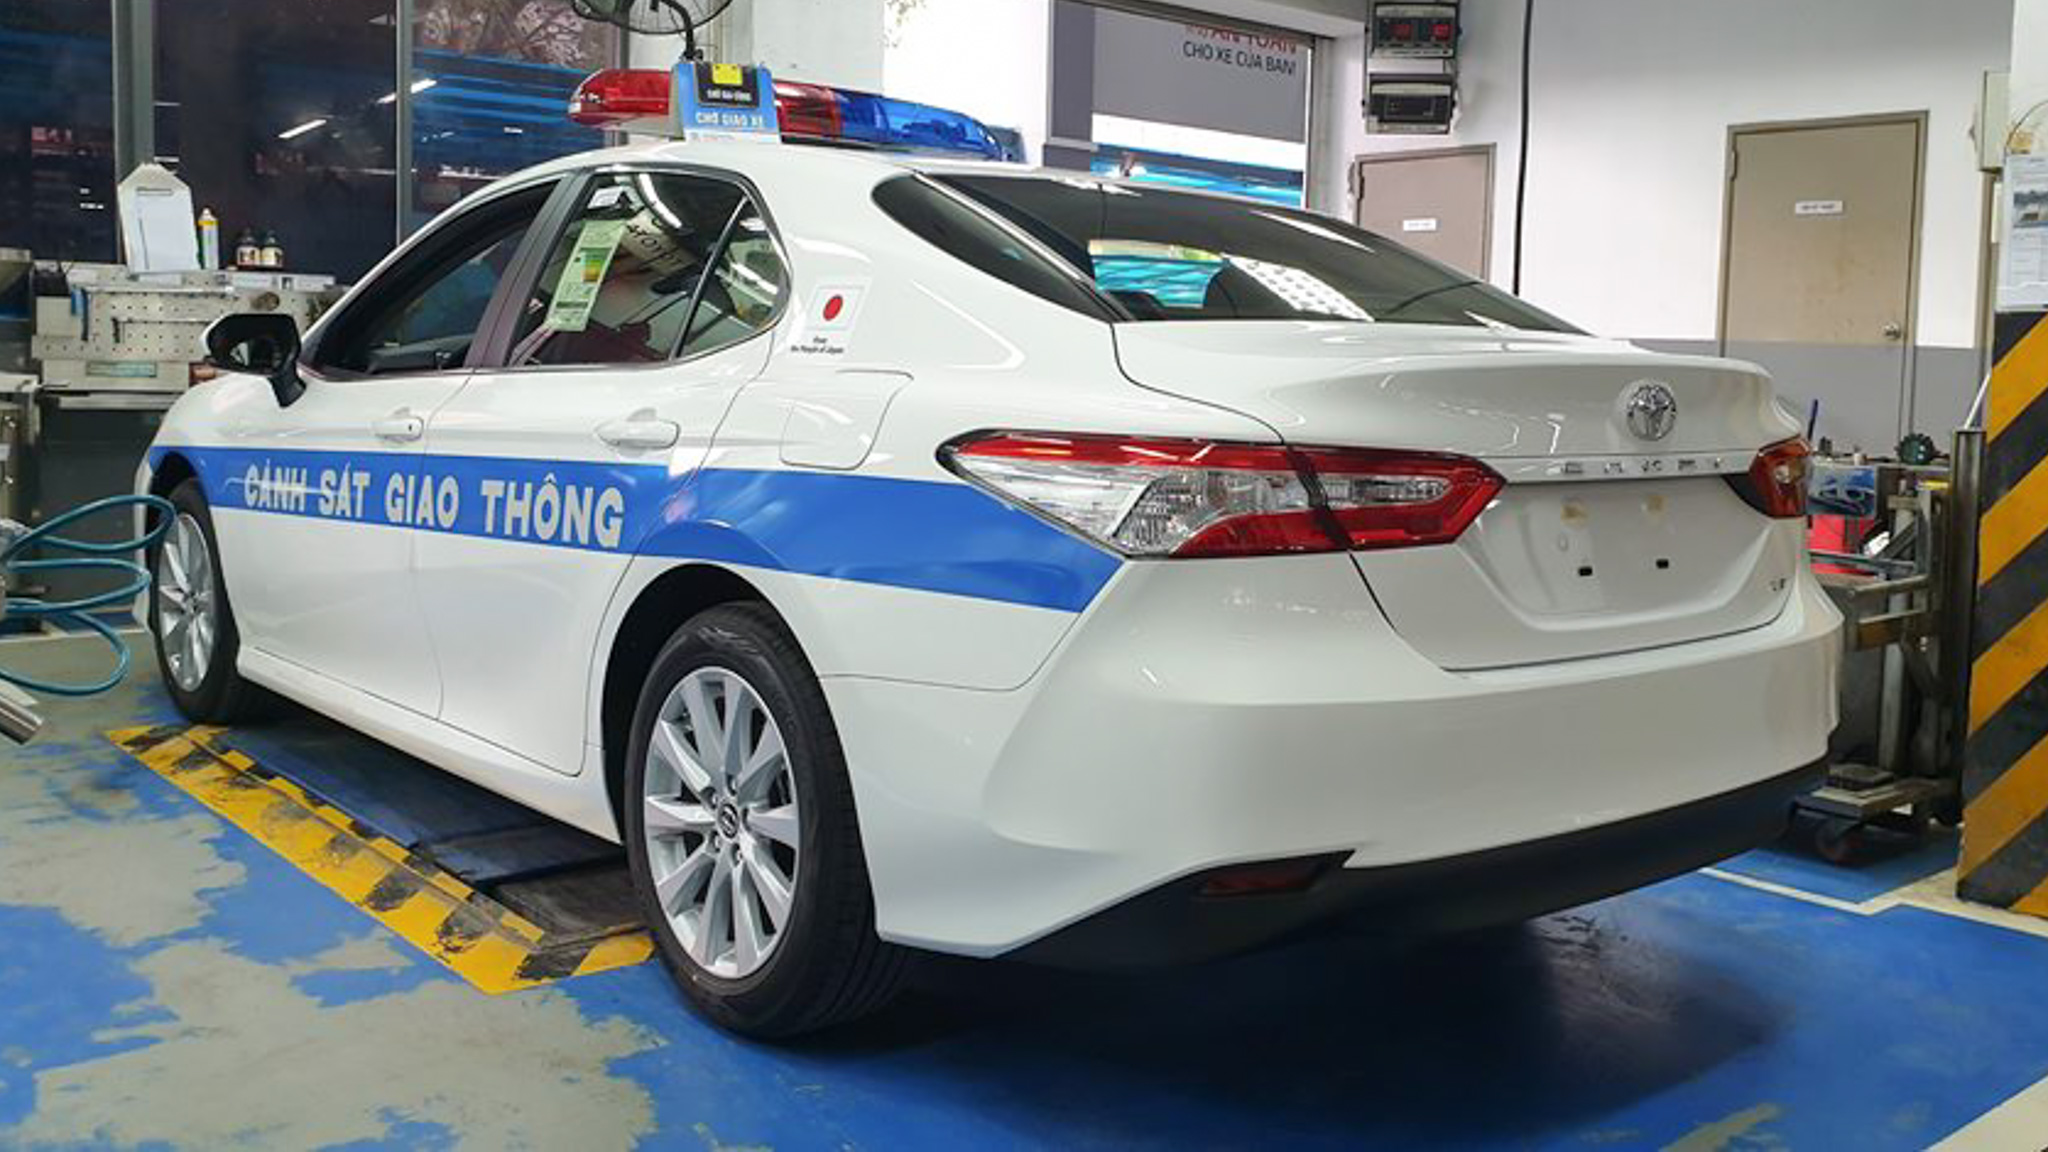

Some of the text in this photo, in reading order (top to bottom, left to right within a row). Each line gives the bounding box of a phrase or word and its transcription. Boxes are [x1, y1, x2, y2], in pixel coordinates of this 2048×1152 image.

[318, 460, 371, 518] SÁT
[385, 472, 459, 529] GIAO
[480, 472, 624, 549] THÔNG
